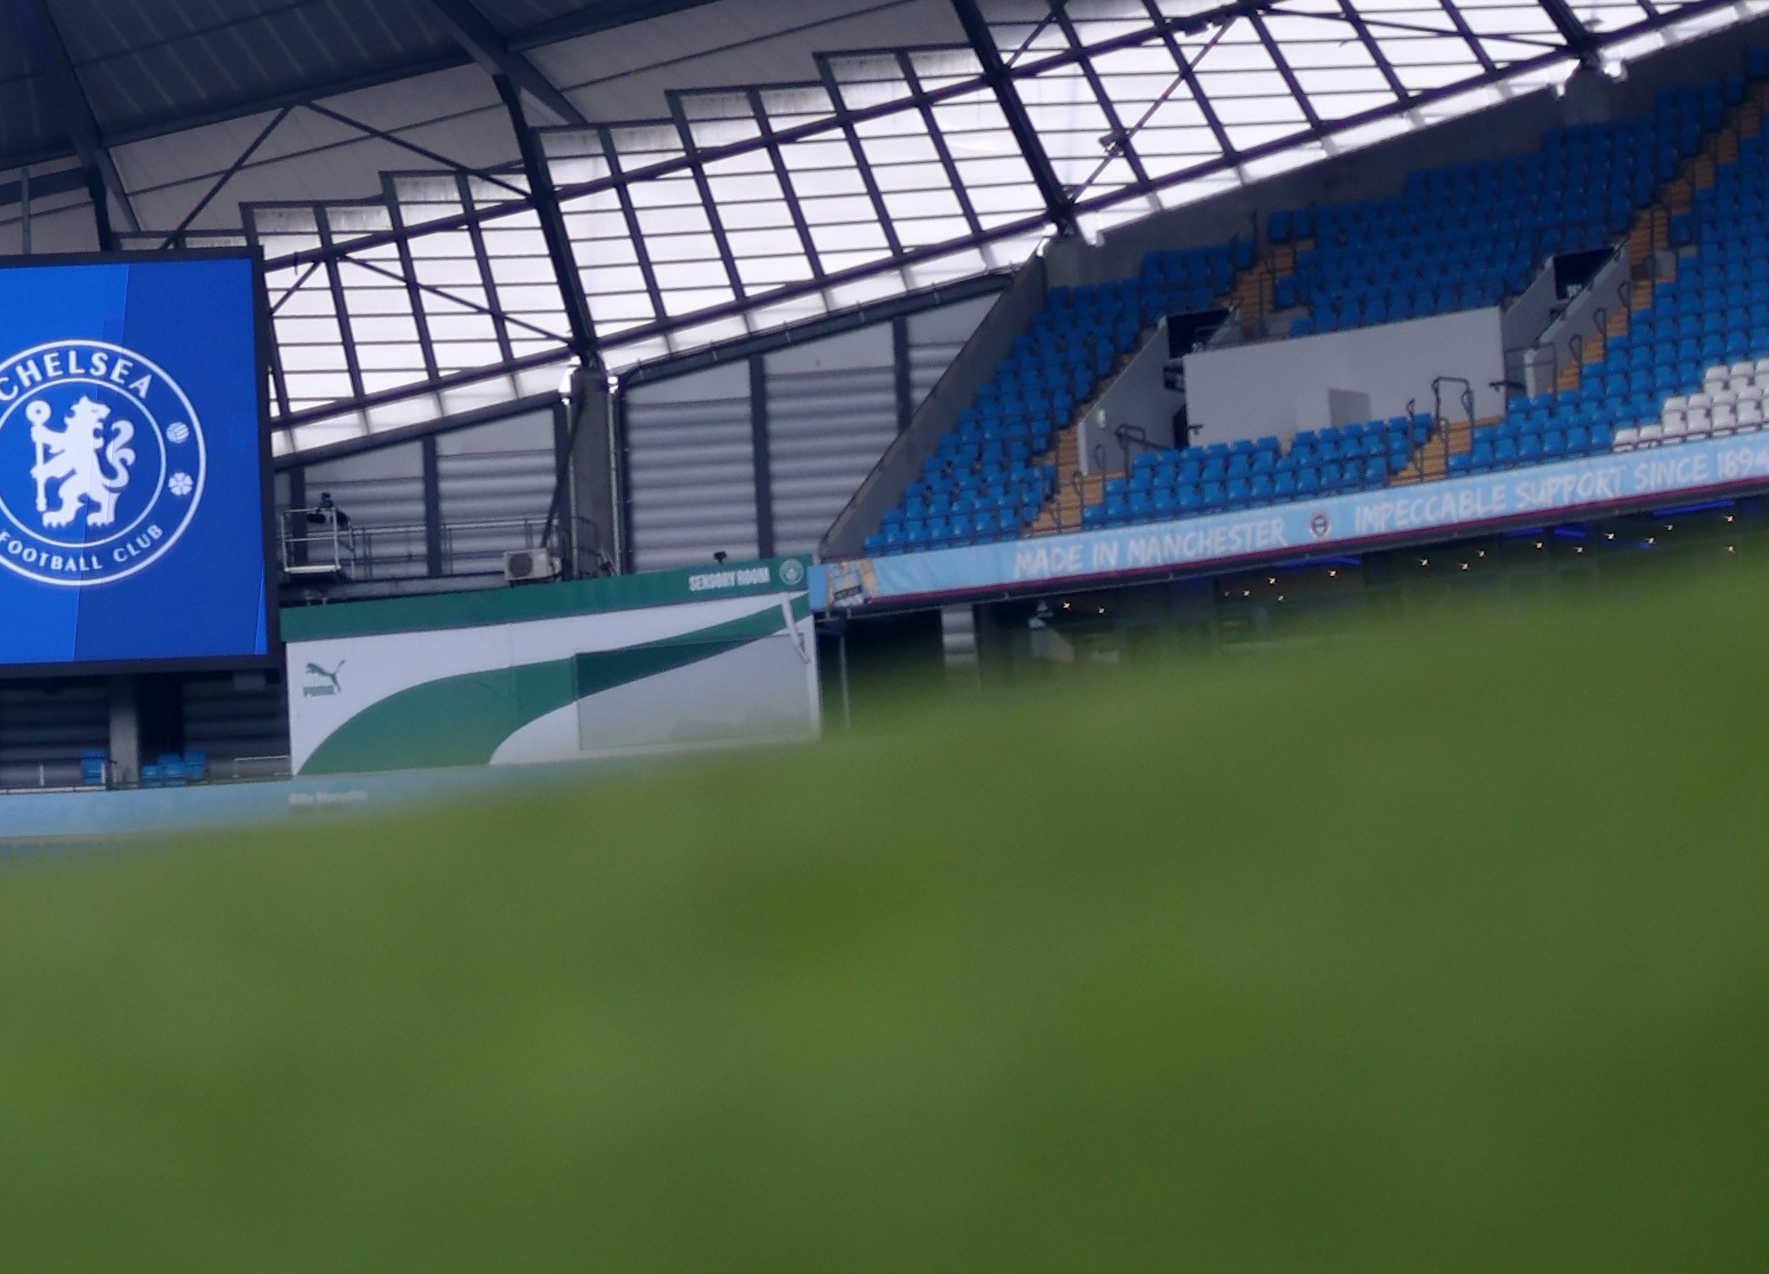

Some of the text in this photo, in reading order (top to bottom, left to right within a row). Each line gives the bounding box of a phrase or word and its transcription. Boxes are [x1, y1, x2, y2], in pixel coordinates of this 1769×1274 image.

[112, 524, 164, 563] CLUB
[1014, 543, 1083, 579] MADE
[1093, 539, 1121, 569] IN
[1126, 517, 1288, 565] MANCHESTER
[1356, 483, 1507, 533] IMPECCABLE
[1515, 465, 1627, 514] SUPPORT
[1634, 452, 1708, 491] SINCE
